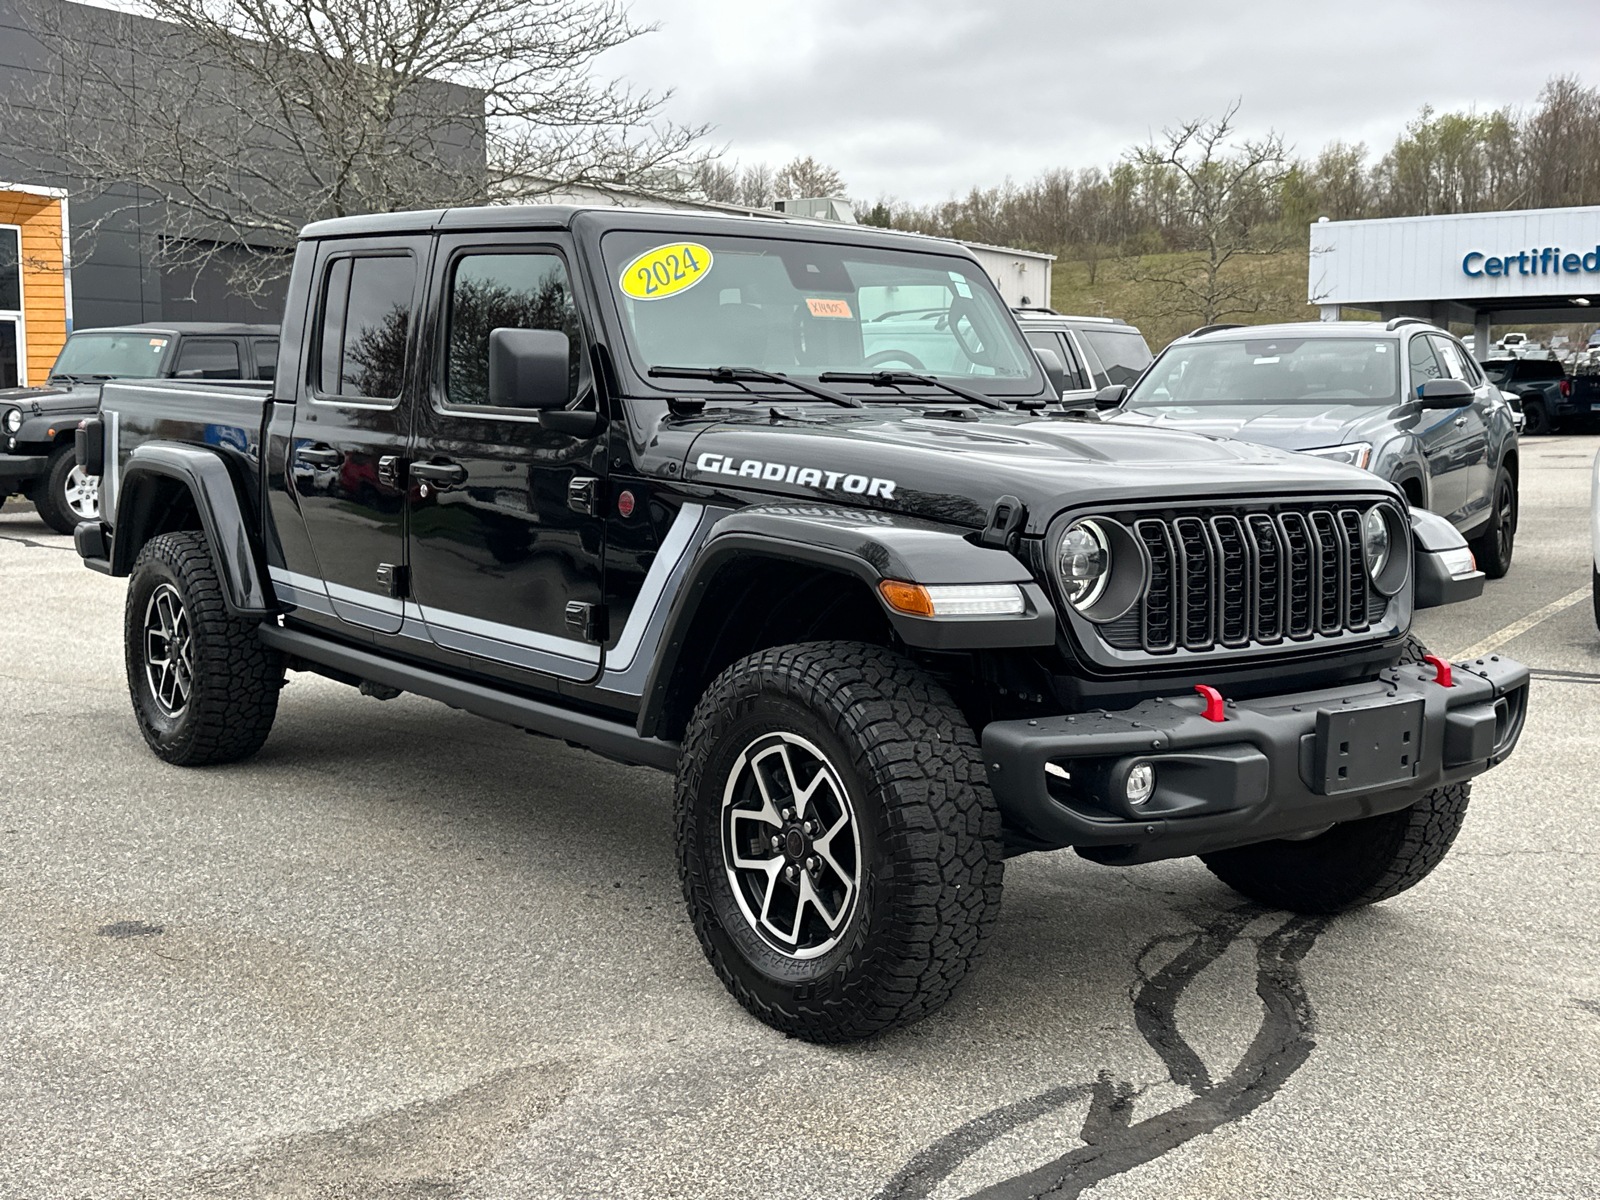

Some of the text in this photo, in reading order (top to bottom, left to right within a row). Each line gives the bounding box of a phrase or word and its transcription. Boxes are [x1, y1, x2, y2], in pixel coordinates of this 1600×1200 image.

[638, 247, 700, 294] 2024
[1462, 245, 1600, 277] Certified
[696, 452, 897, 500] GLADIATOR
